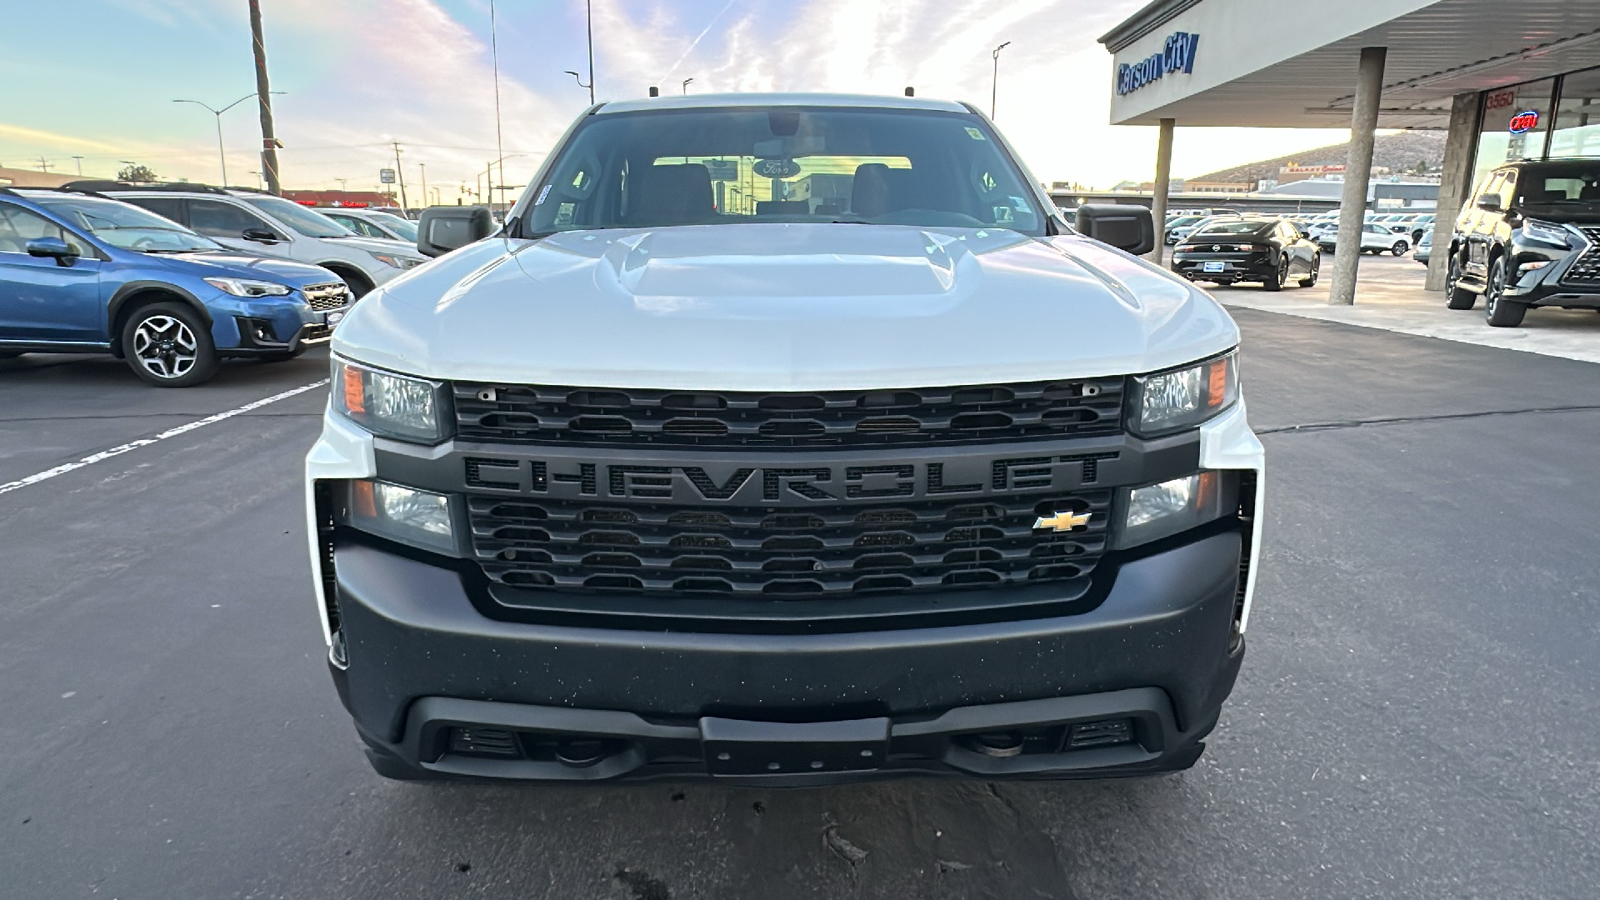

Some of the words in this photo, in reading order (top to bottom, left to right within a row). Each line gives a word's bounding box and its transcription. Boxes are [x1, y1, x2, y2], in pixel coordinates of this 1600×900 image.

[1117, 53, 1163, 96] Carson
[1162, 31, 1199, 74] City
[1509, 115, 1537, 130] OPEN
[464, 451, 1120, 501] CHEVROLET
